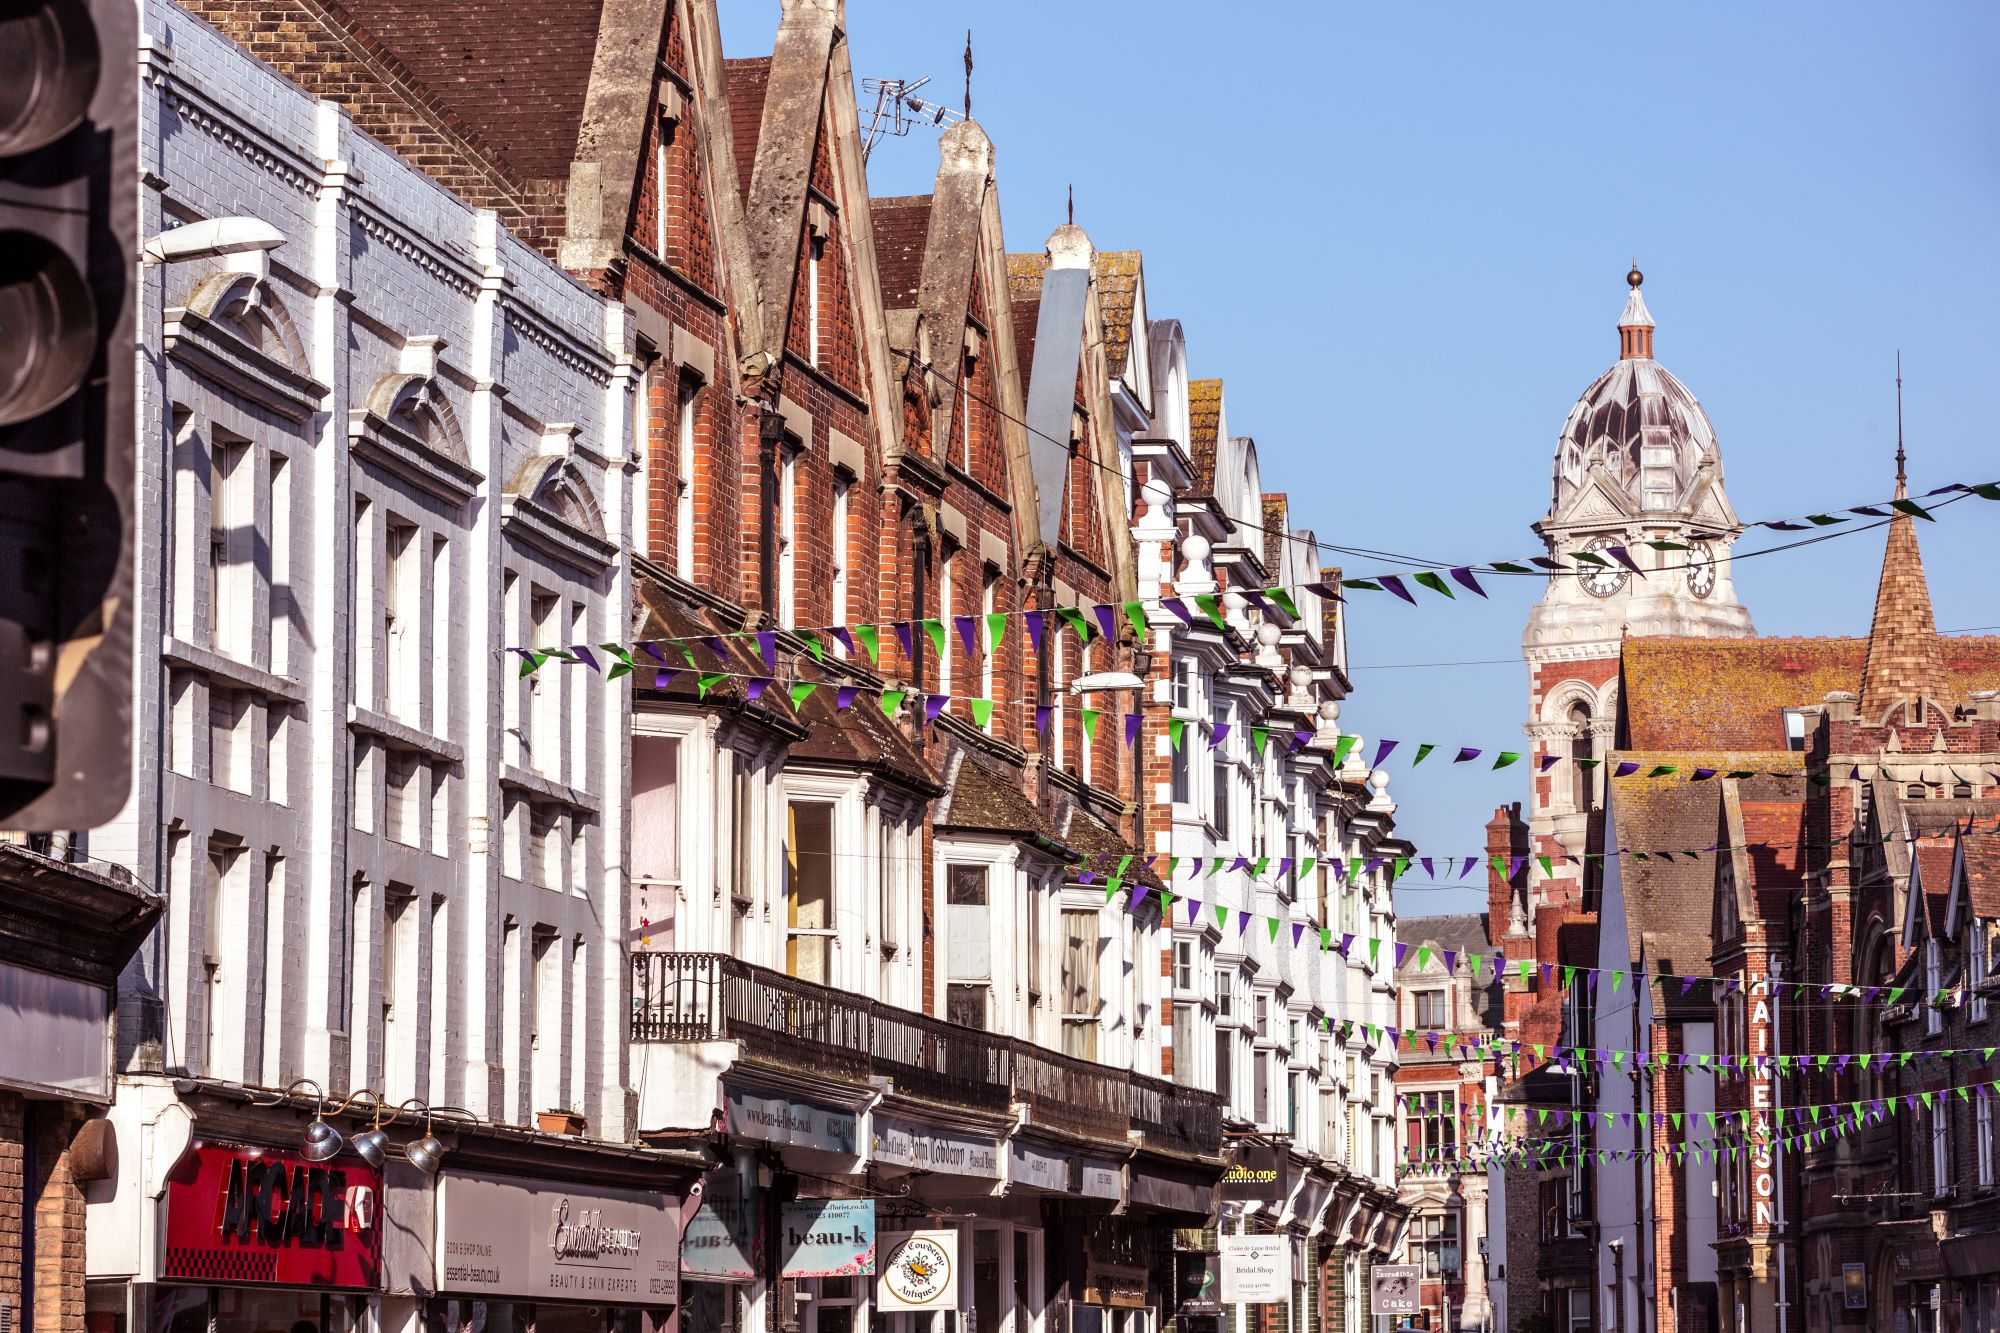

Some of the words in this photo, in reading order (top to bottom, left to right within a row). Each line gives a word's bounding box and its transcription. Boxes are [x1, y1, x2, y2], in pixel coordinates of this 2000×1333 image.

[1751, 972, 1773, 1108] HAINE
[930, 1136, 965, 1166] Cowderoy
[1256, 1170, 1277, 1182] one
[1753, 1144, 1776, 1225] SON
[218, 1158, 346, 1250] ARCADE
[600, 1227, 641, 1253] BEAUTY
[787, 1224, 867, 1246] beau-k
[889, 1247, 906, 1269] John
[908, 1241, 945, 1266] Cowderoy
[1236, 1266, 1256, 1274] Bridal
[1257, 1266, 1274, 1274] Shop
[550, 1273, 578, 1289] BEAUTY
[581, 1276, 585, 1289] &
[588, 1276, 605, 1291] SKIN
[607, 1278, 637, 1293] EXPERTS
[898, 1285, 937, 1299] Antiques
[1382, 1299, 1413, 1308] Cake
